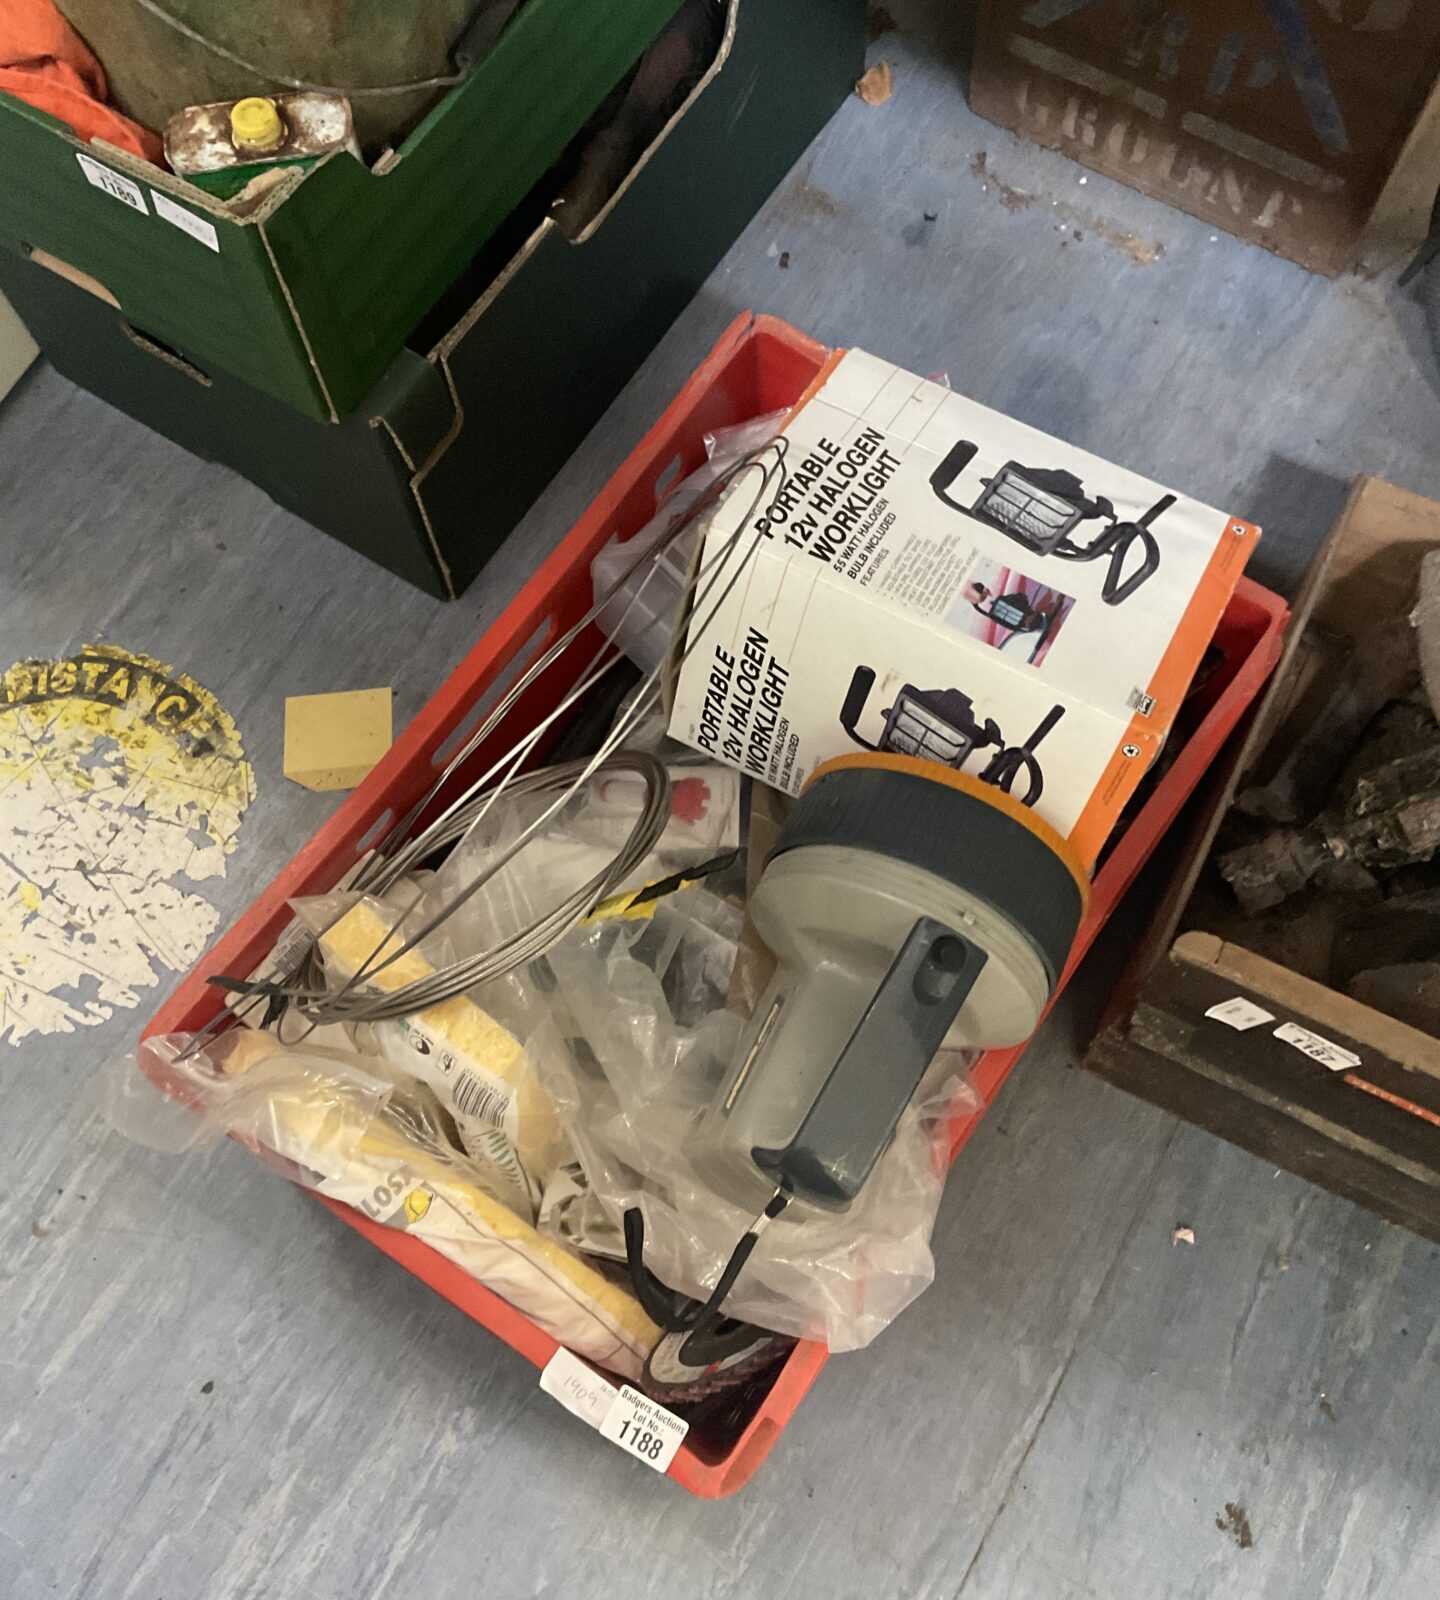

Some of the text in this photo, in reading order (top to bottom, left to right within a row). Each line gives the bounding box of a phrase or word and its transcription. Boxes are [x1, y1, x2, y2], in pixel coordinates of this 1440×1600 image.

[100, 177, 137, 206] 1189
[754, 437, 841, 539] PORTABLE
[784, 427, 885, 549] 12v HALOGEN
[808, 449, 901, 563] WORKLIGHT
[833, 498, 889, 573] 55 WATT HALOGEN
[847, 512, 896, 579] BULB INCLUDED
[860, 548, 890, 586] FEATURES
[697, 645, 735, 753] PORTABLE
[722, 626, 769, 763] 12v HALOGEN
[745, 656, 790, 776] WORKLIGHT
[768, 717, 790, 784] 55 WATT HALOGEN
[779, 733, 799, 790] BULB INCLUDED
[1292, 1038, 1336, 1062] 1187
[619, 1419, 663, 1460] 1188
[622, 1388, 652, 1414] Badgers
[653, 1409, 685, 1435] Auctions
[633, 1411, 646, 1426] Lot
